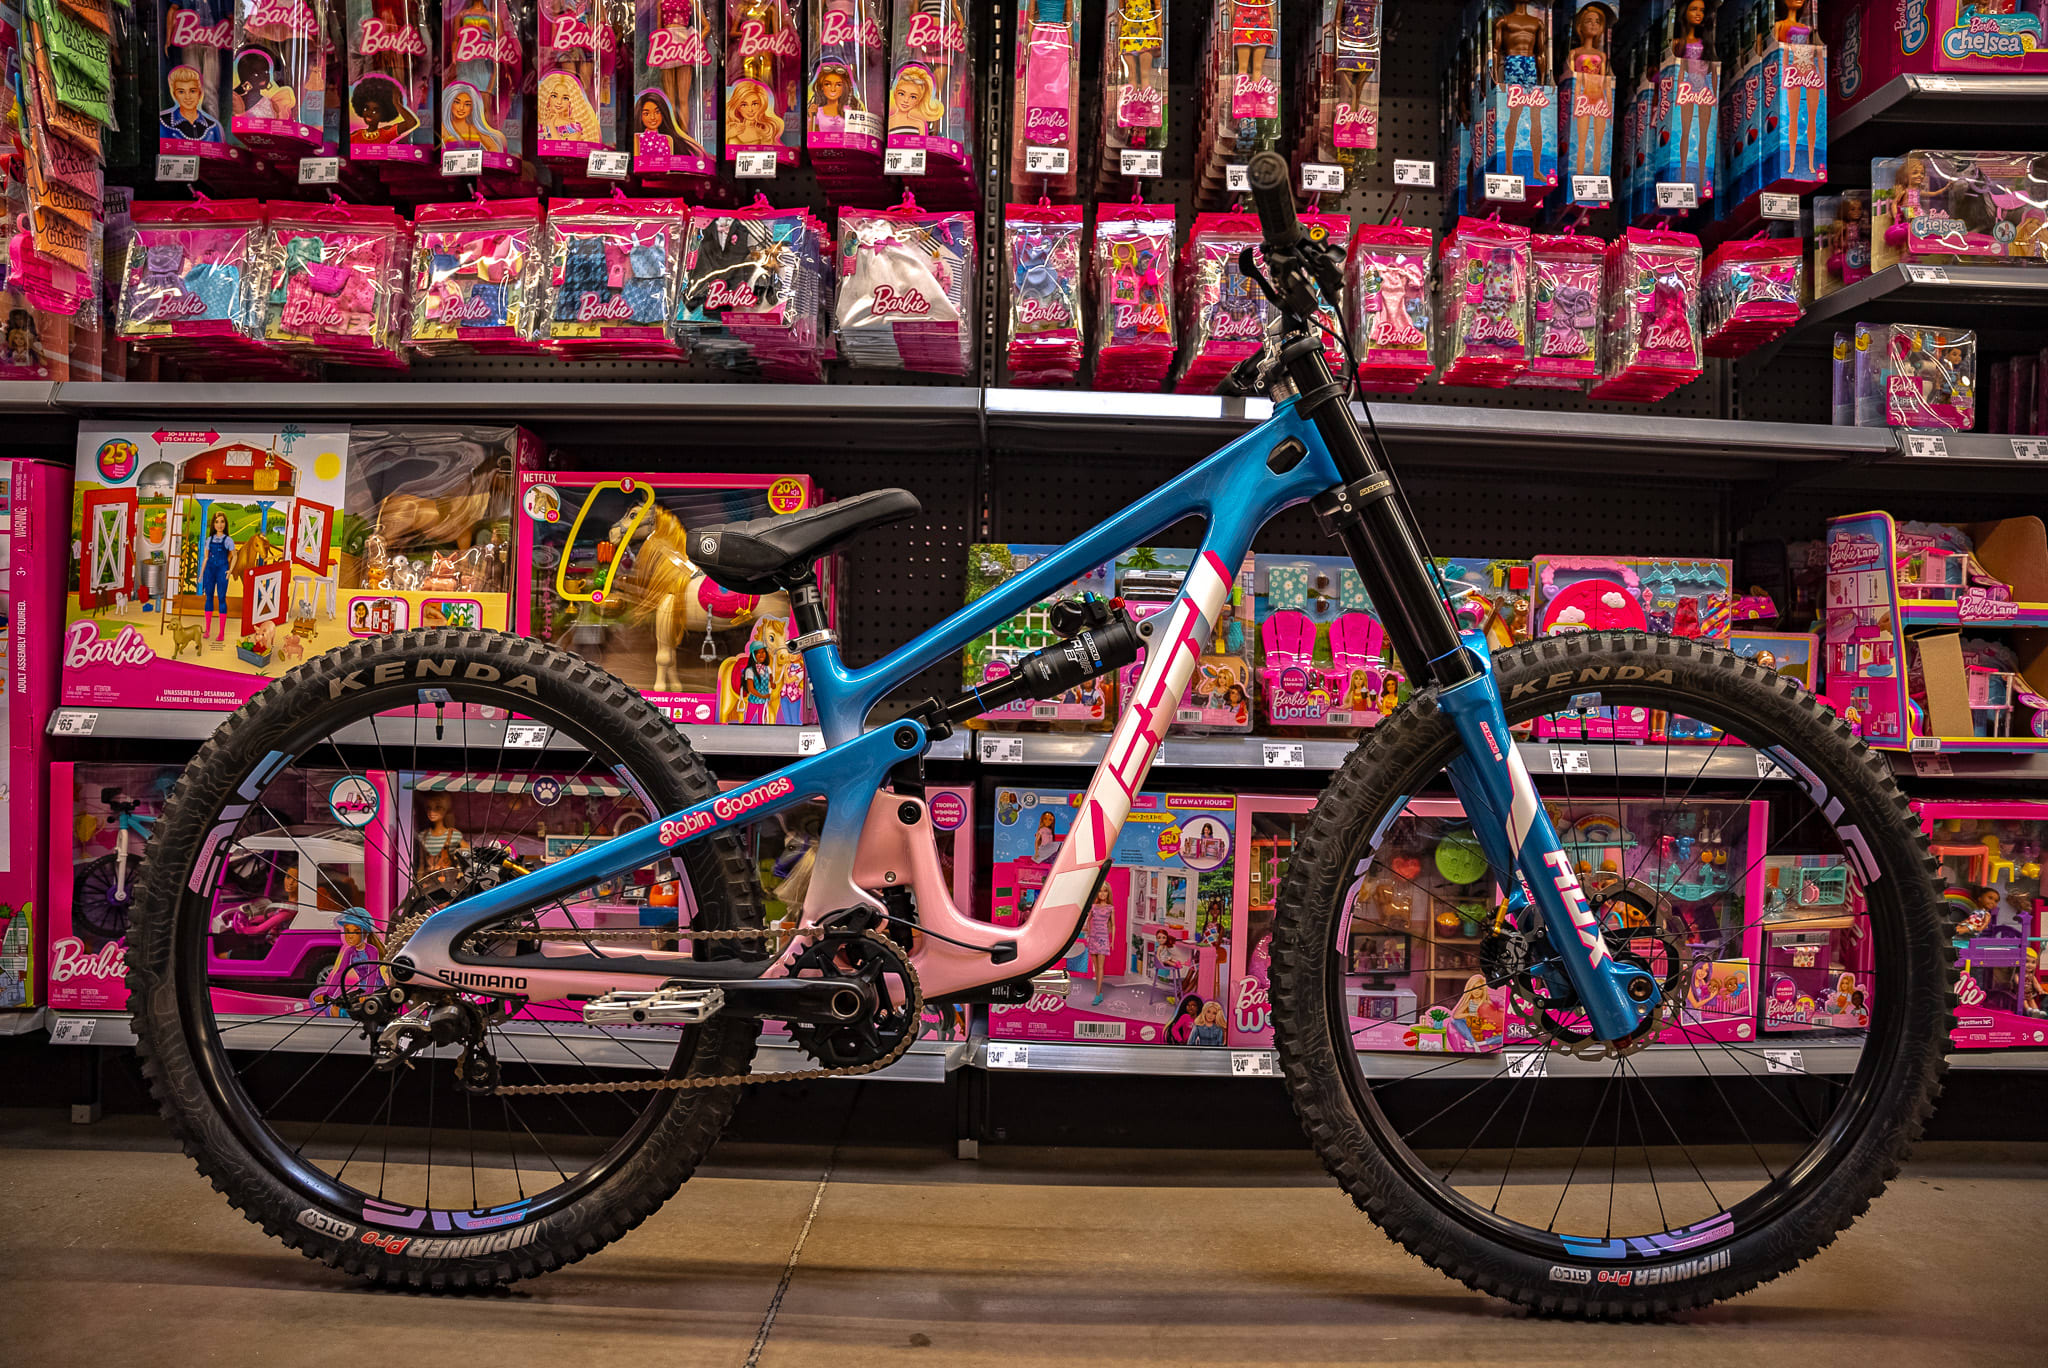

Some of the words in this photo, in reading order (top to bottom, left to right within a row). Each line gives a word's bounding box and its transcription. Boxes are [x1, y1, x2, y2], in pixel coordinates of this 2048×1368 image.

[251, 0, 319, 33] Barbie
[174, 12, 234, 48] Barbi
[362, 21, 425, 54] Barbie
[554, 16, 613, 52] Barbie
[740, 22, 798, 57] Barbie
[823, 12, 881, 49] Barbie
[908, 14, 966, 52] Barbie
[1948, 29, 2021, 56] Chelsea
[458, 28, 519, 64] Barbie
[648, 30, 711, 65] Barbie
[1234, 74, 1278, 96] Barbie
[1784, 66, 1824, 89] Barbie
[1119, 85, 1162, 104] Barbie
[1507, 85, 1550, 108] Barbie
[1574, 95, 1612, 117] Barbie
[1677, 82, 1718, 106] Barbie
[1028, 108, 1068, 127] Barbie
[1336, 104, 1376, 125] Barbie
[1912, 217, 1965, 237] Chelsea
[706, 280, 757, 309] Barbie
[1228, 274, 1248, 297] K
[153, 292, 205, 318] Barbie
[441, 296, 492, 323] Barbie
[579, 294, 633, 321] Barbie
[873, 285, 930, 315] Barbie
[1022, 299, 1069, 323] Barbie
[292, 300, 343, 326] Barbie
[1117, 304, 1164, 329] Barbie
[1214, 313, 1261, 338] Barbie
[1378, 322, 1424, 346] Barbie
[1474, 316, 1519, 341] Barbie
[1647, 325, 1691, 350] Barbie
[1542, 333, 1589, 356] Barbie
[103, 442, 139, 465] 25+
[523, 473, 557, 484] NETFLIX
[1959, 596, 1993, 615] Barbie
[1993, 603, 2019, 615] Land
[17, 636, 27, 671] ASSEMBLY
[65, 621, 154, 669] Barbie
[17, 673, 27, 694] ADULT
[329, 658, 538, 700] KENDA
[1510, 665, 1674, 700] KENDA
[163, 689, 201, 697] UNASSEMBLED
[203, 690, 235, 698] DESARMADO
[193, 696, 213, 704] REQUER
[213, 697, 243, 705] MONTAGEM
[1273, 688, 1308, 706] Barbie
[58, 719, 73, 731] $65
[660, 806, 713, 843] Robin
[713, 776, 790, 819] Goomes
[1169, 798, 1200, 806] GETAWAY
[1543, 849, 1614, 970] RUX
[438, 969, 528, 990] SHIMANO
[1768, 998, 1797, 1016] Barbie
[361, 1231, 410, 1255] Pro
[406, 1230, 517, 1259] PINNER
[1598, 1270, 1633, 1287] Pro
[1634, 1254, 1710, 1286] PINNER
